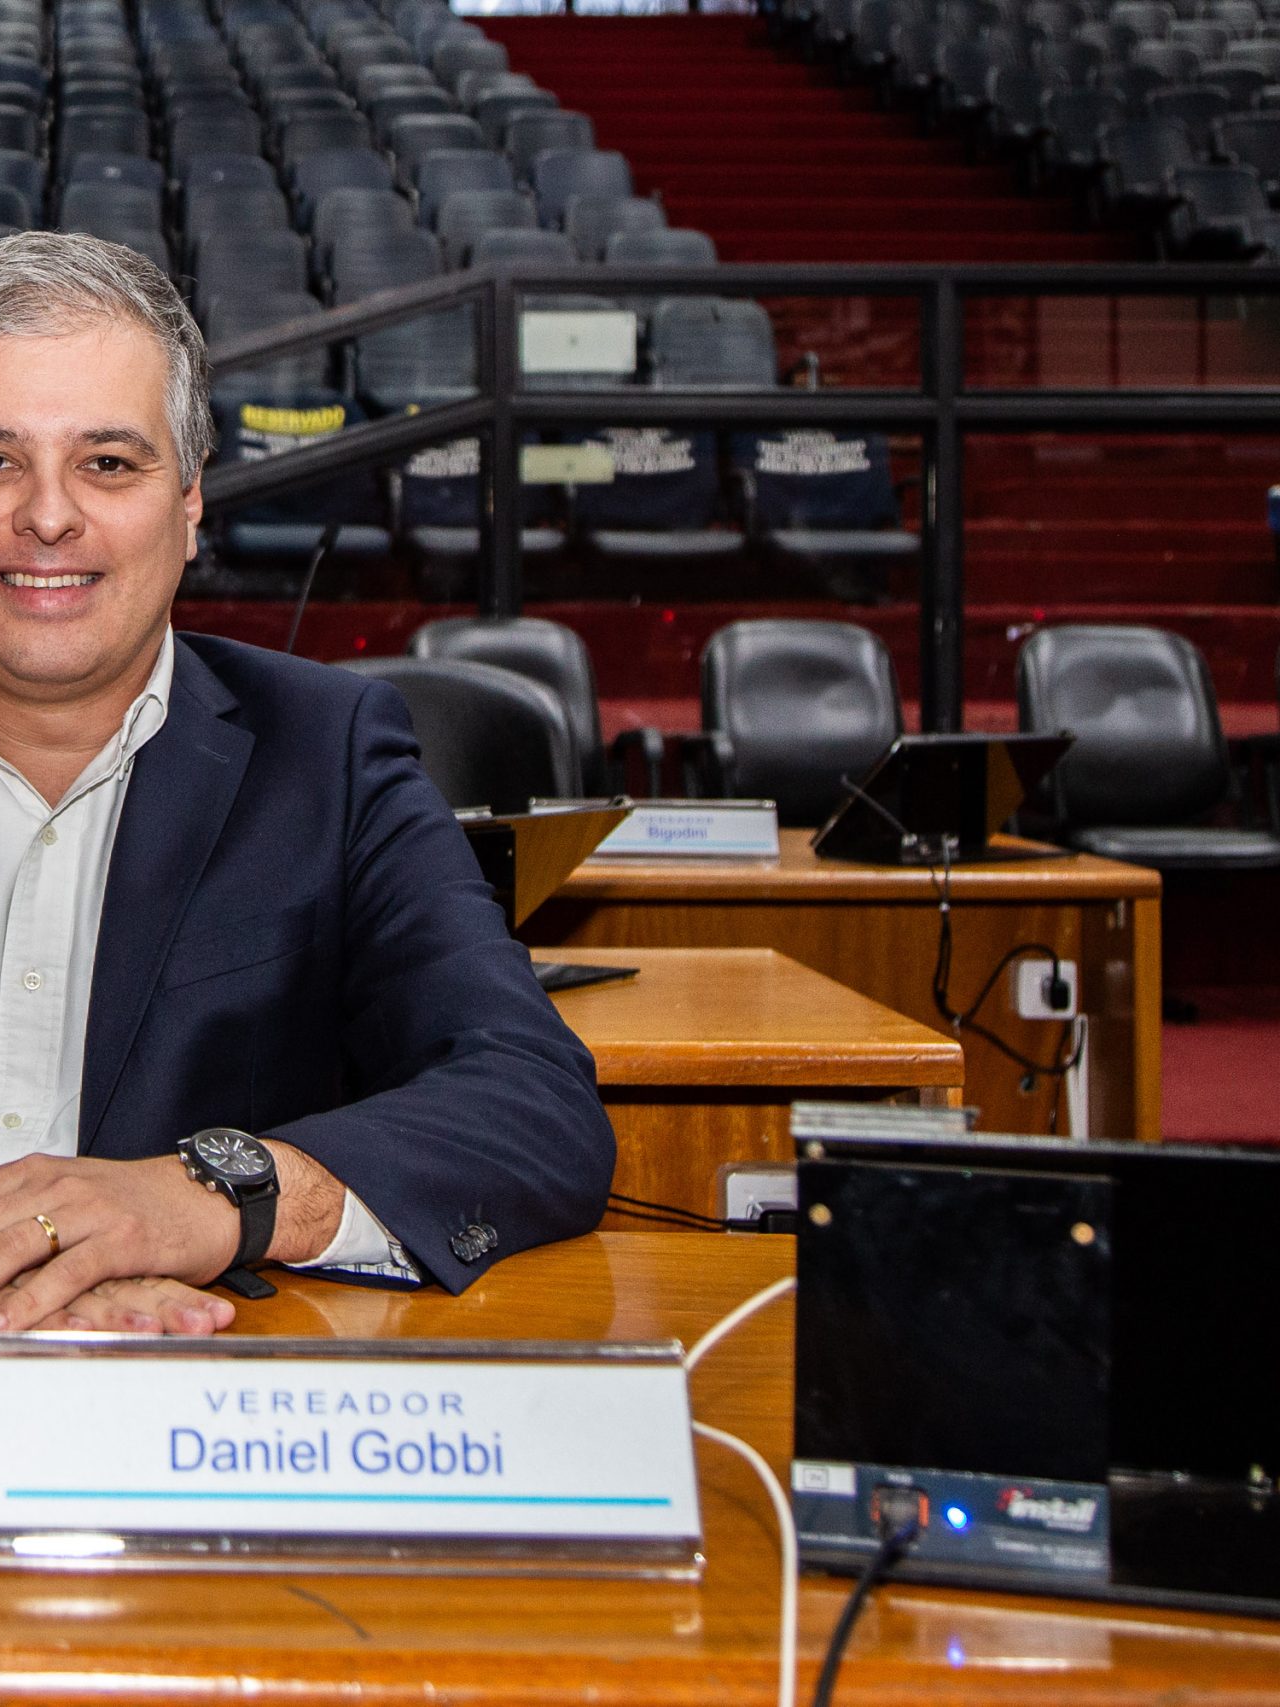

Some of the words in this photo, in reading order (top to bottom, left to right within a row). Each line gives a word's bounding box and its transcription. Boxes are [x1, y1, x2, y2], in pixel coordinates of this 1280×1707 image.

[240, 404, 346, 435] RESERVADO
[648, 826, 708, 842] Bigodini
[205, 1389, 464, 1416] VEREADOR
[170, 1428, 329, 1474] Daniel
[351, 1429, 503, 1476] Gobbi
